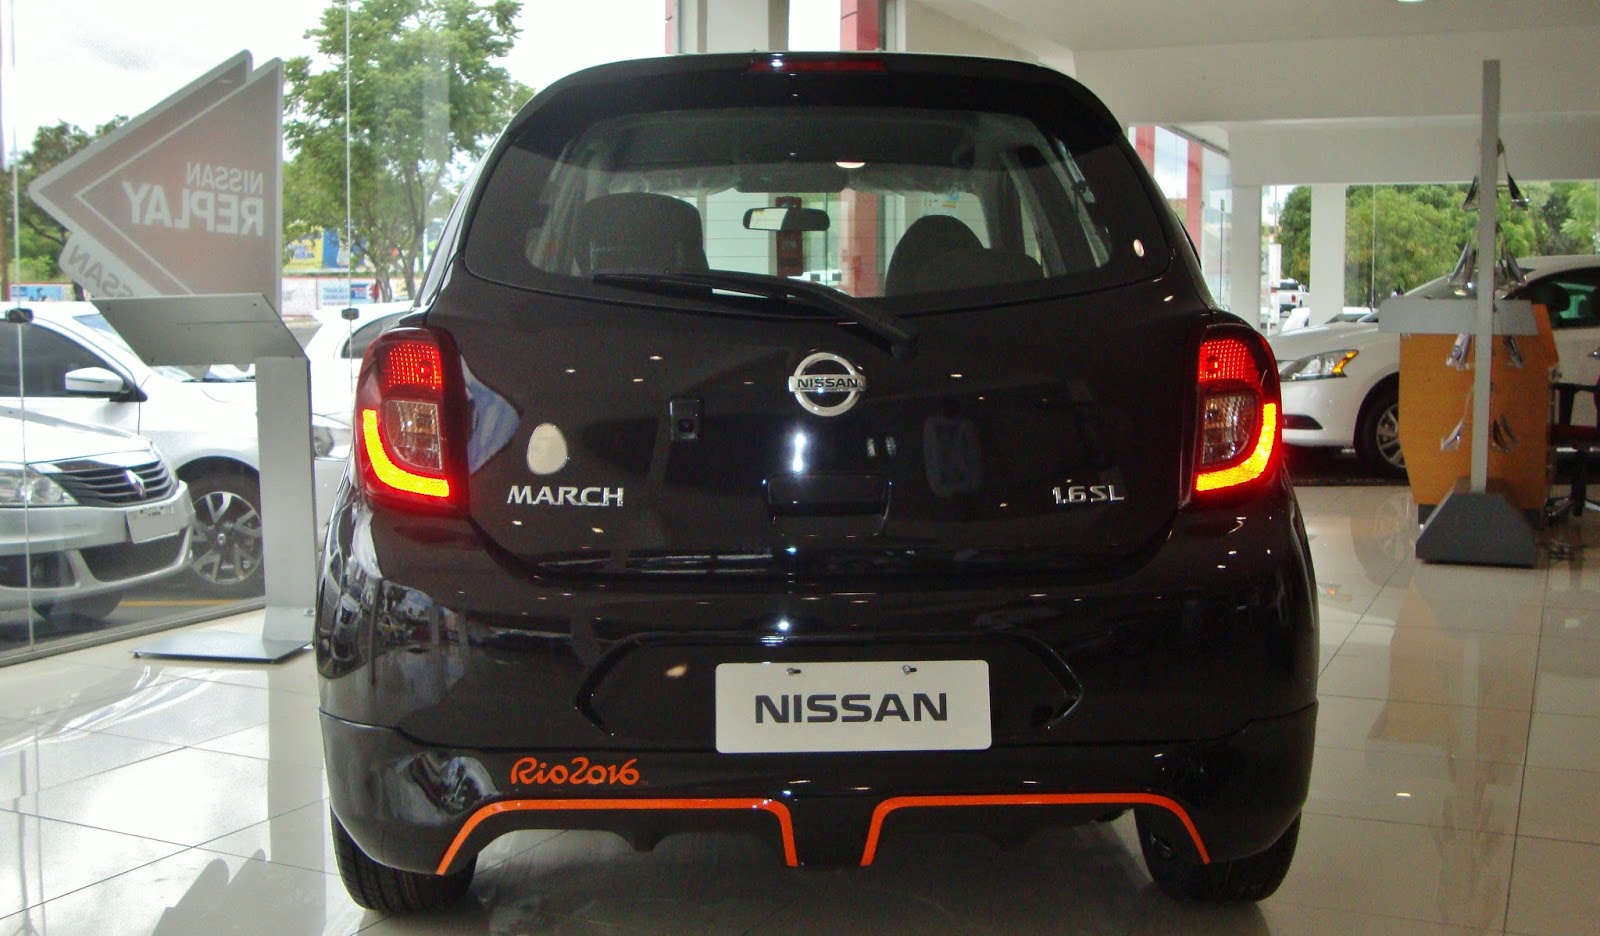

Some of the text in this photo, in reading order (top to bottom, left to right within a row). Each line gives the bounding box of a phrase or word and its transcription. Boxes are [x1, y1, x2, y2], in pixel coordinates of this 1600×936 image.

[797, 378, 858, 388] NISSAN
[507, 485, 624, 507] MARCH
[755, 693, 948, 723] NISSAN
[510, 756, 640, 786] Rio2016
